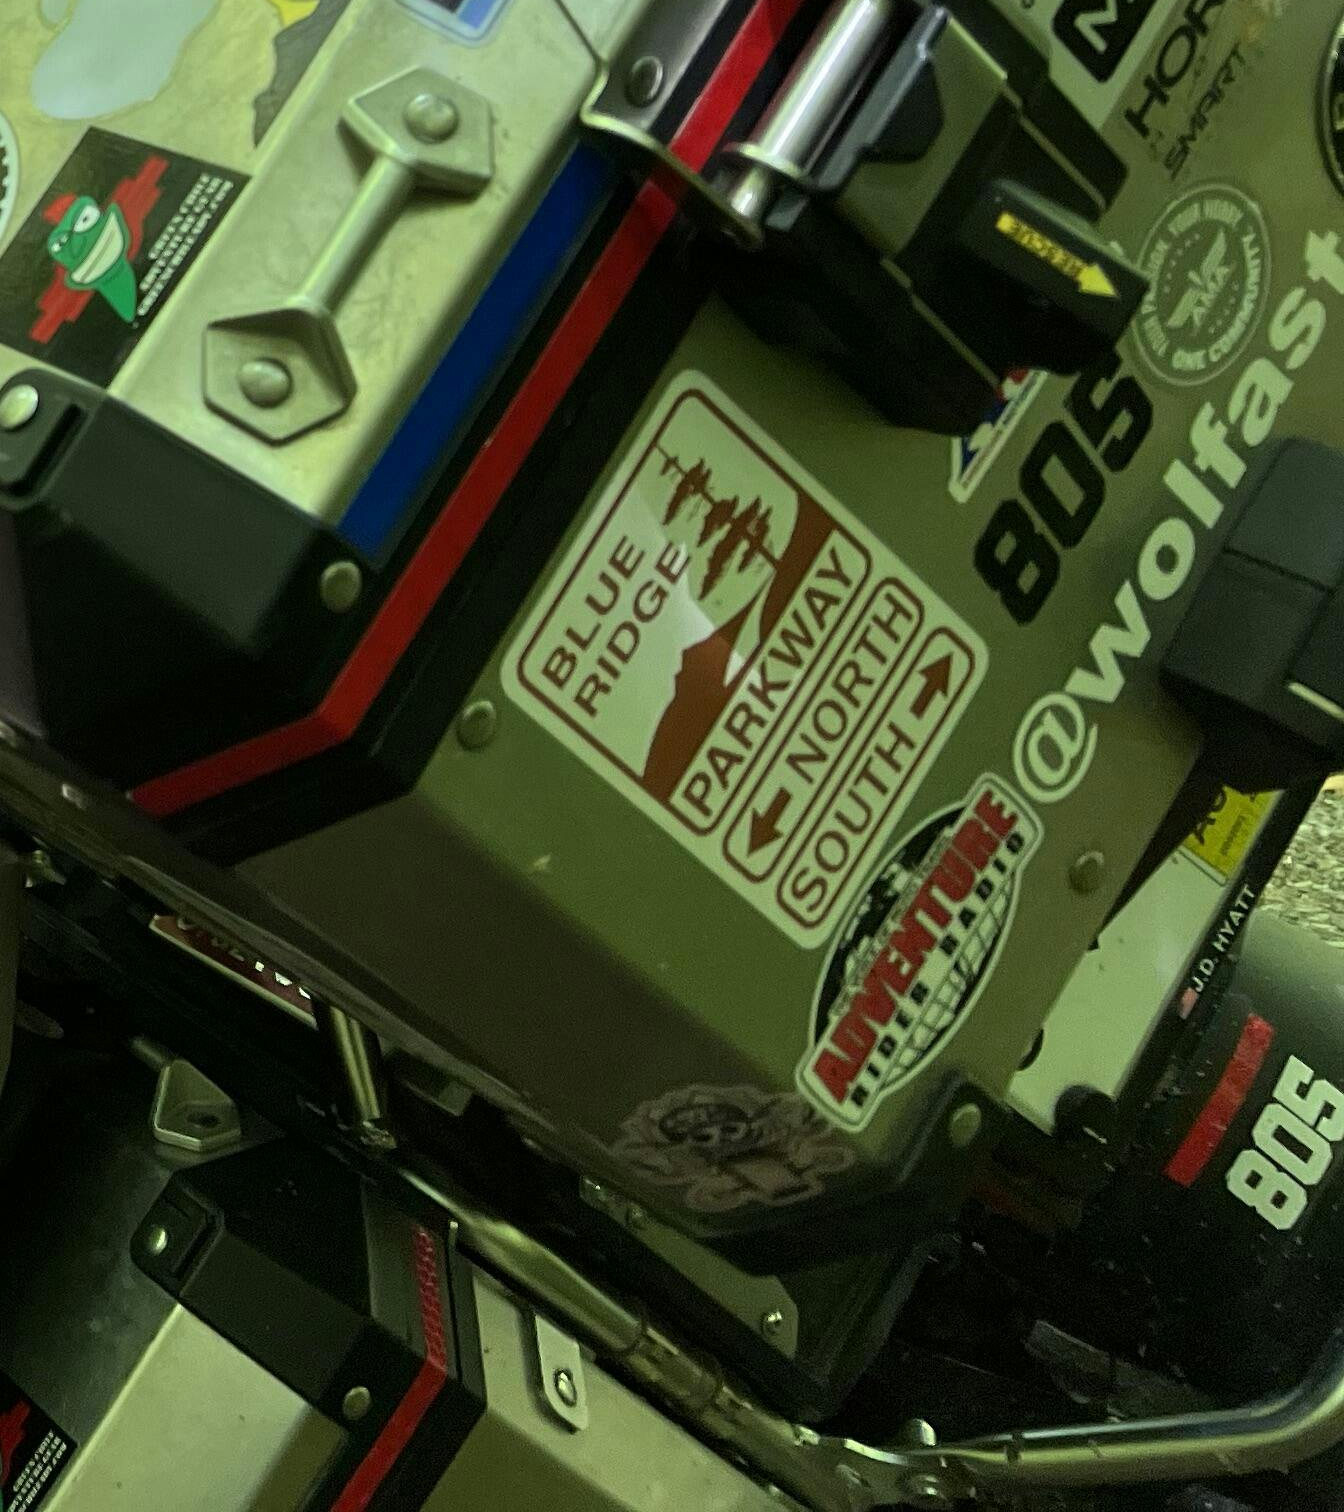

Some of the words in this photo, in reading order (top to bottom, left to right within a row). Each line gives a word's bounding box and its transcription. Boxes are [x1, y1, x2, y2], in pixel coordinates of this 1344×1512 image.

[972, 360, 1154, 627] 805
[541, 535, 646, 690] BLUE
[572, 542, 691, 718] RIDGE
[682, 546, 854, 818] PARKWAY
[784, 591, 914, 784] NORTH
[790, 721, 918, 912] SOUTH
[813, 789, 1019, 1105] ADVENTURE
[850, 981, 929, 1107] RIDER
[941, 831, 1025, 956] RADIO
[1193, 956, 1218, 994] J.D.
[1211, 883, 1257, 954] HYATT
[1225, 1054, 1344, 1231] 805
